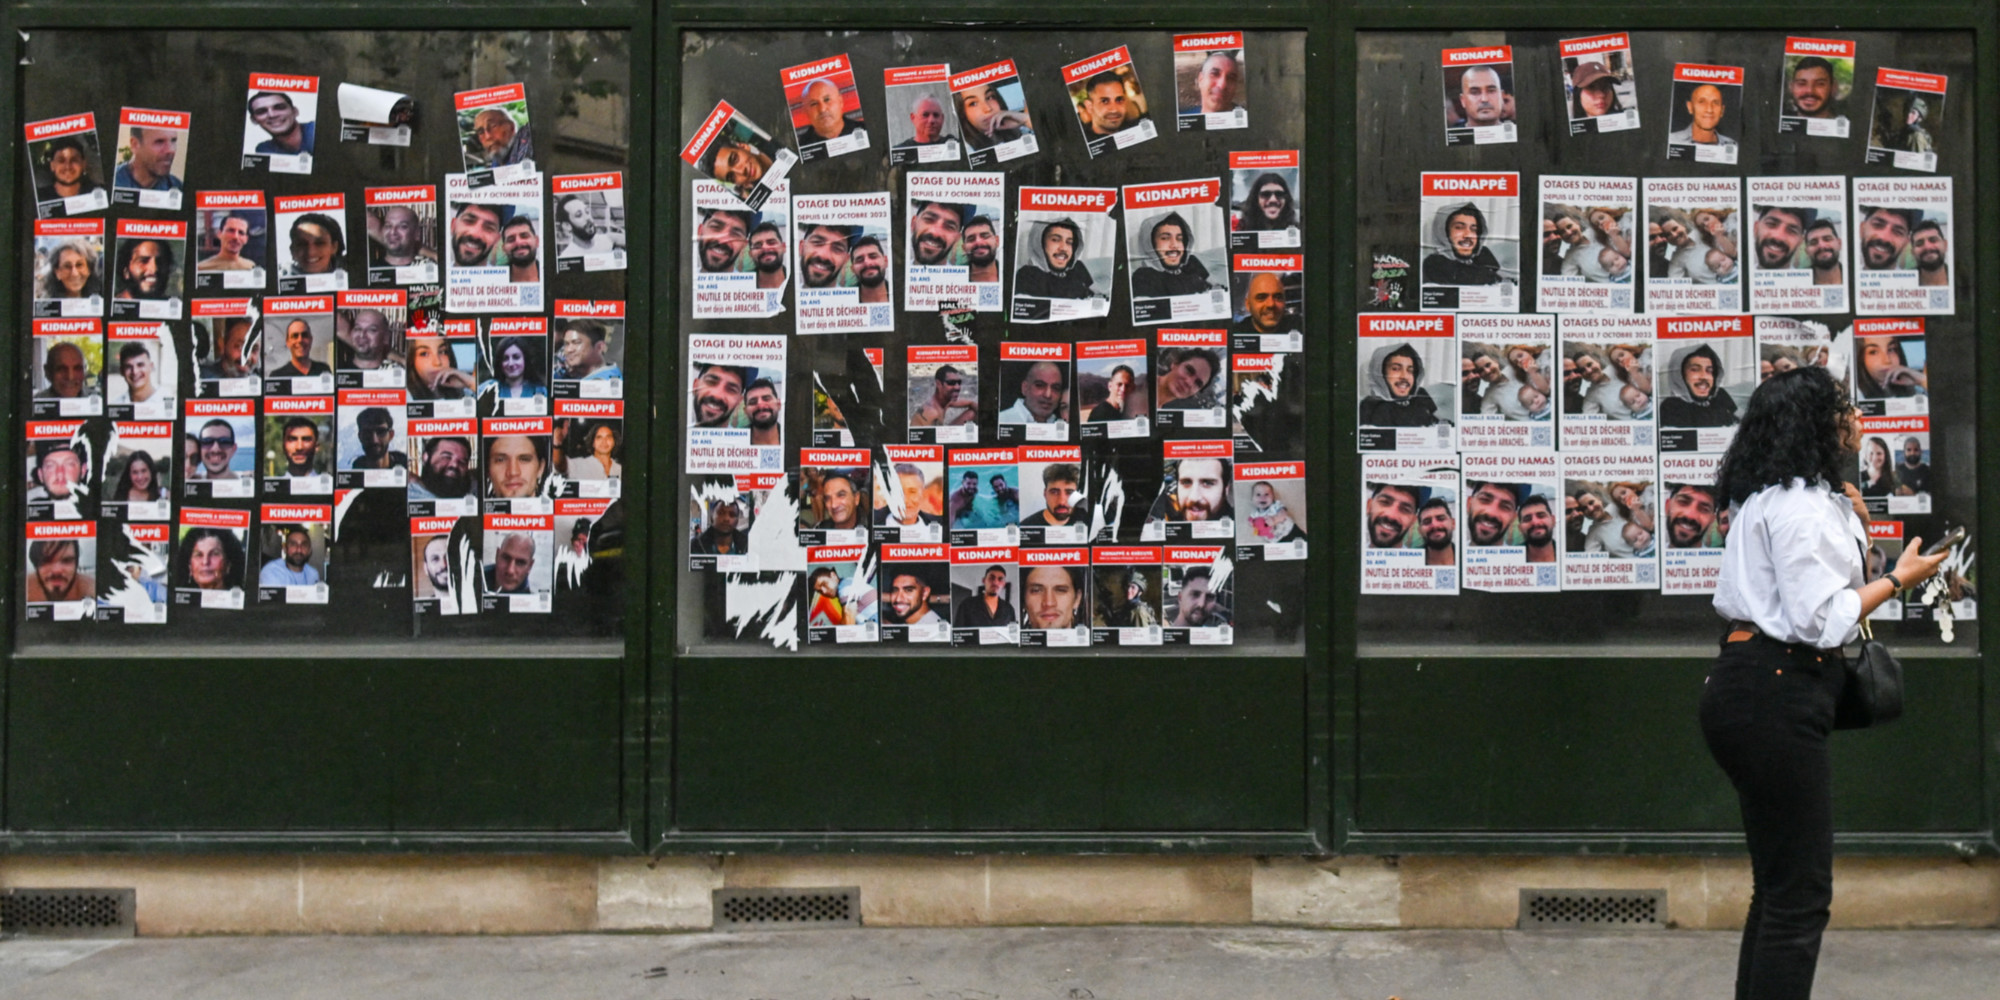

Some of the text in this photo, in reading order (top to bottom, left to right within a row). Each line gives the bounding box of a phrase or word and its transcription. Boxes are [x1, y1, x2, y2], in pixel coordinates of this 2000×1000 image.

[1182, 34, 1234, 48] KIDNAPPÉ
[1565, 37, 1624, 53] KIDNAPPÉE
[1793, 41, 1846, 54] KIDNAPPÉ
[1450, 48, 1503, 62] KIDNAPPÉ
[789, 58, 842, 80] KIDNAPPÉ
[1071, 51, 1121, 77] KIDNAPPÉ
[953, 63, 1011, 87] KIDNAPPÉE
[1682, 67, 1735, 80] KIDNAPPÉ
[257, 77, 310, 90] KIDNAPPÉ
[129, 112, 181, 126] KIDNAPPÉ
[34, 116, 86, 136] KIDNAPPÉ
[689, 109, 726, 157] KIDNAPPÉ
[561, 175, 613, 189] KIDNAPPÉ
[911, 177, 1000, 185] OTAGE DU HAMAS
[1433, 176, 1507, 191] KIDNAPPÉ
[1544, 180, 1579, 189] OTAGES
[1648, 183, 1684, 191] OTAGES
[1703, 183, 1736, 191] HAMAS
[1752, 183, 1784, 191] OTAGE
[1805, 182, 1840, 190] HAMAS
[1858, 183, 1890, 191] OTAGE
[1910, 183, 1946, 191] HAMAS
[375, 188, 427, 201] KIDNAPPÉ
[697, 184, 726, 193] OTAG
[1135, 183, 1209, 203] KIDNAPPÉ
[205, 193, 258, 205] KIDNAPPÉ
[280, 196, 339, 210] KIDNAPPÉE
[798, 200, 829, 208] OTAGE
[850, 198, 885, 207] HAMAS
[1032, 192, 1105, 207] KIDNAPPÉ
[125, 223, 178, 235] KIDNAPPÉ
[1242, 257, 1294, 268] KIDNAPPÉ
[910, 285, 933, 294] INUTILE
[946, 283, 976, 294] DÉCHIRER
[346, 292, 398, 304] KIDNAPPÉ
[697, 292, 720, 301] INUTILE
[733, 290, 764, 300] DÉCHIRER
[272, 298, 325, 311] KIDNAPPÉ
[800, 308, 824, 317] INUTILE
[837, 305, 867, 316] DÉCHIRER
[41, 320, 94, 332] KIDNAPPÉ
[1370, 317, 1443, 332] KIDNAPPÉ
[1563, 318, 1598, 326] OTAGES
[1618, 318, 1651, 326] HAMAS
[1668, 318, 1741, 333] KIDNAPPÉ
[1162, 331, 1222, 343] KIDNAPPÉE
[693, 340, 782, 348] OTAGE DU HAMAS
[1009, 345, 1062, 357] KIDNAPPÉ
[194, 402, 247, 413] KIDNAPPÉ
[272, 399, 325, 411] KIDNAPPÉ
[562, 402, 615, 414] KIDNAPPÉ
[416, 421, 469, 433] KIDNAPPÉ
[491, 419, 544, 432] KIDNAPPÉ
[691, 448, 714, 456] INUTILE
[727, 447, 758, 457] DÉCHIRER
[809, 451, 862, 463] KIDNAPPÉ
[890, 448, 934, 458] IDNAPPÉ
[953, 451, 1014, 462] KIDNAPPÉS
[1026, 449, 1080, 458] KIDNAPPÉ
[1366, 459, 1398, 467] OTAGE
[1402, 460, 1416, 468] DU
[1466, 457, 1555, 465] OTAGE DU HAMAS
[1565, 456, 1600, 464] OTAGES
[1620, 456, 1654, 464] HAMAS
[1664, 460, 1695, 468] OTAGE
[1242, 464, 1296, 477] KIDNAPPÉ
[269, 507, 322, 519] KIDNAPPÉ
[492, 516, 546, 527] KIDNAPPÉ
[35, 523, 88, 536] KIDNAPPÉ
[890, 546, 942, 556] KIDNAPPÉ
[958, 548, 1012, 560] KIDNAPPÉ
[1026, 552, 1080, 561] KIDNAPPÉ
[1467, 566, 1490, 575] INUTILE
[1503, 564, 1533, 575] DÉCHIRER
